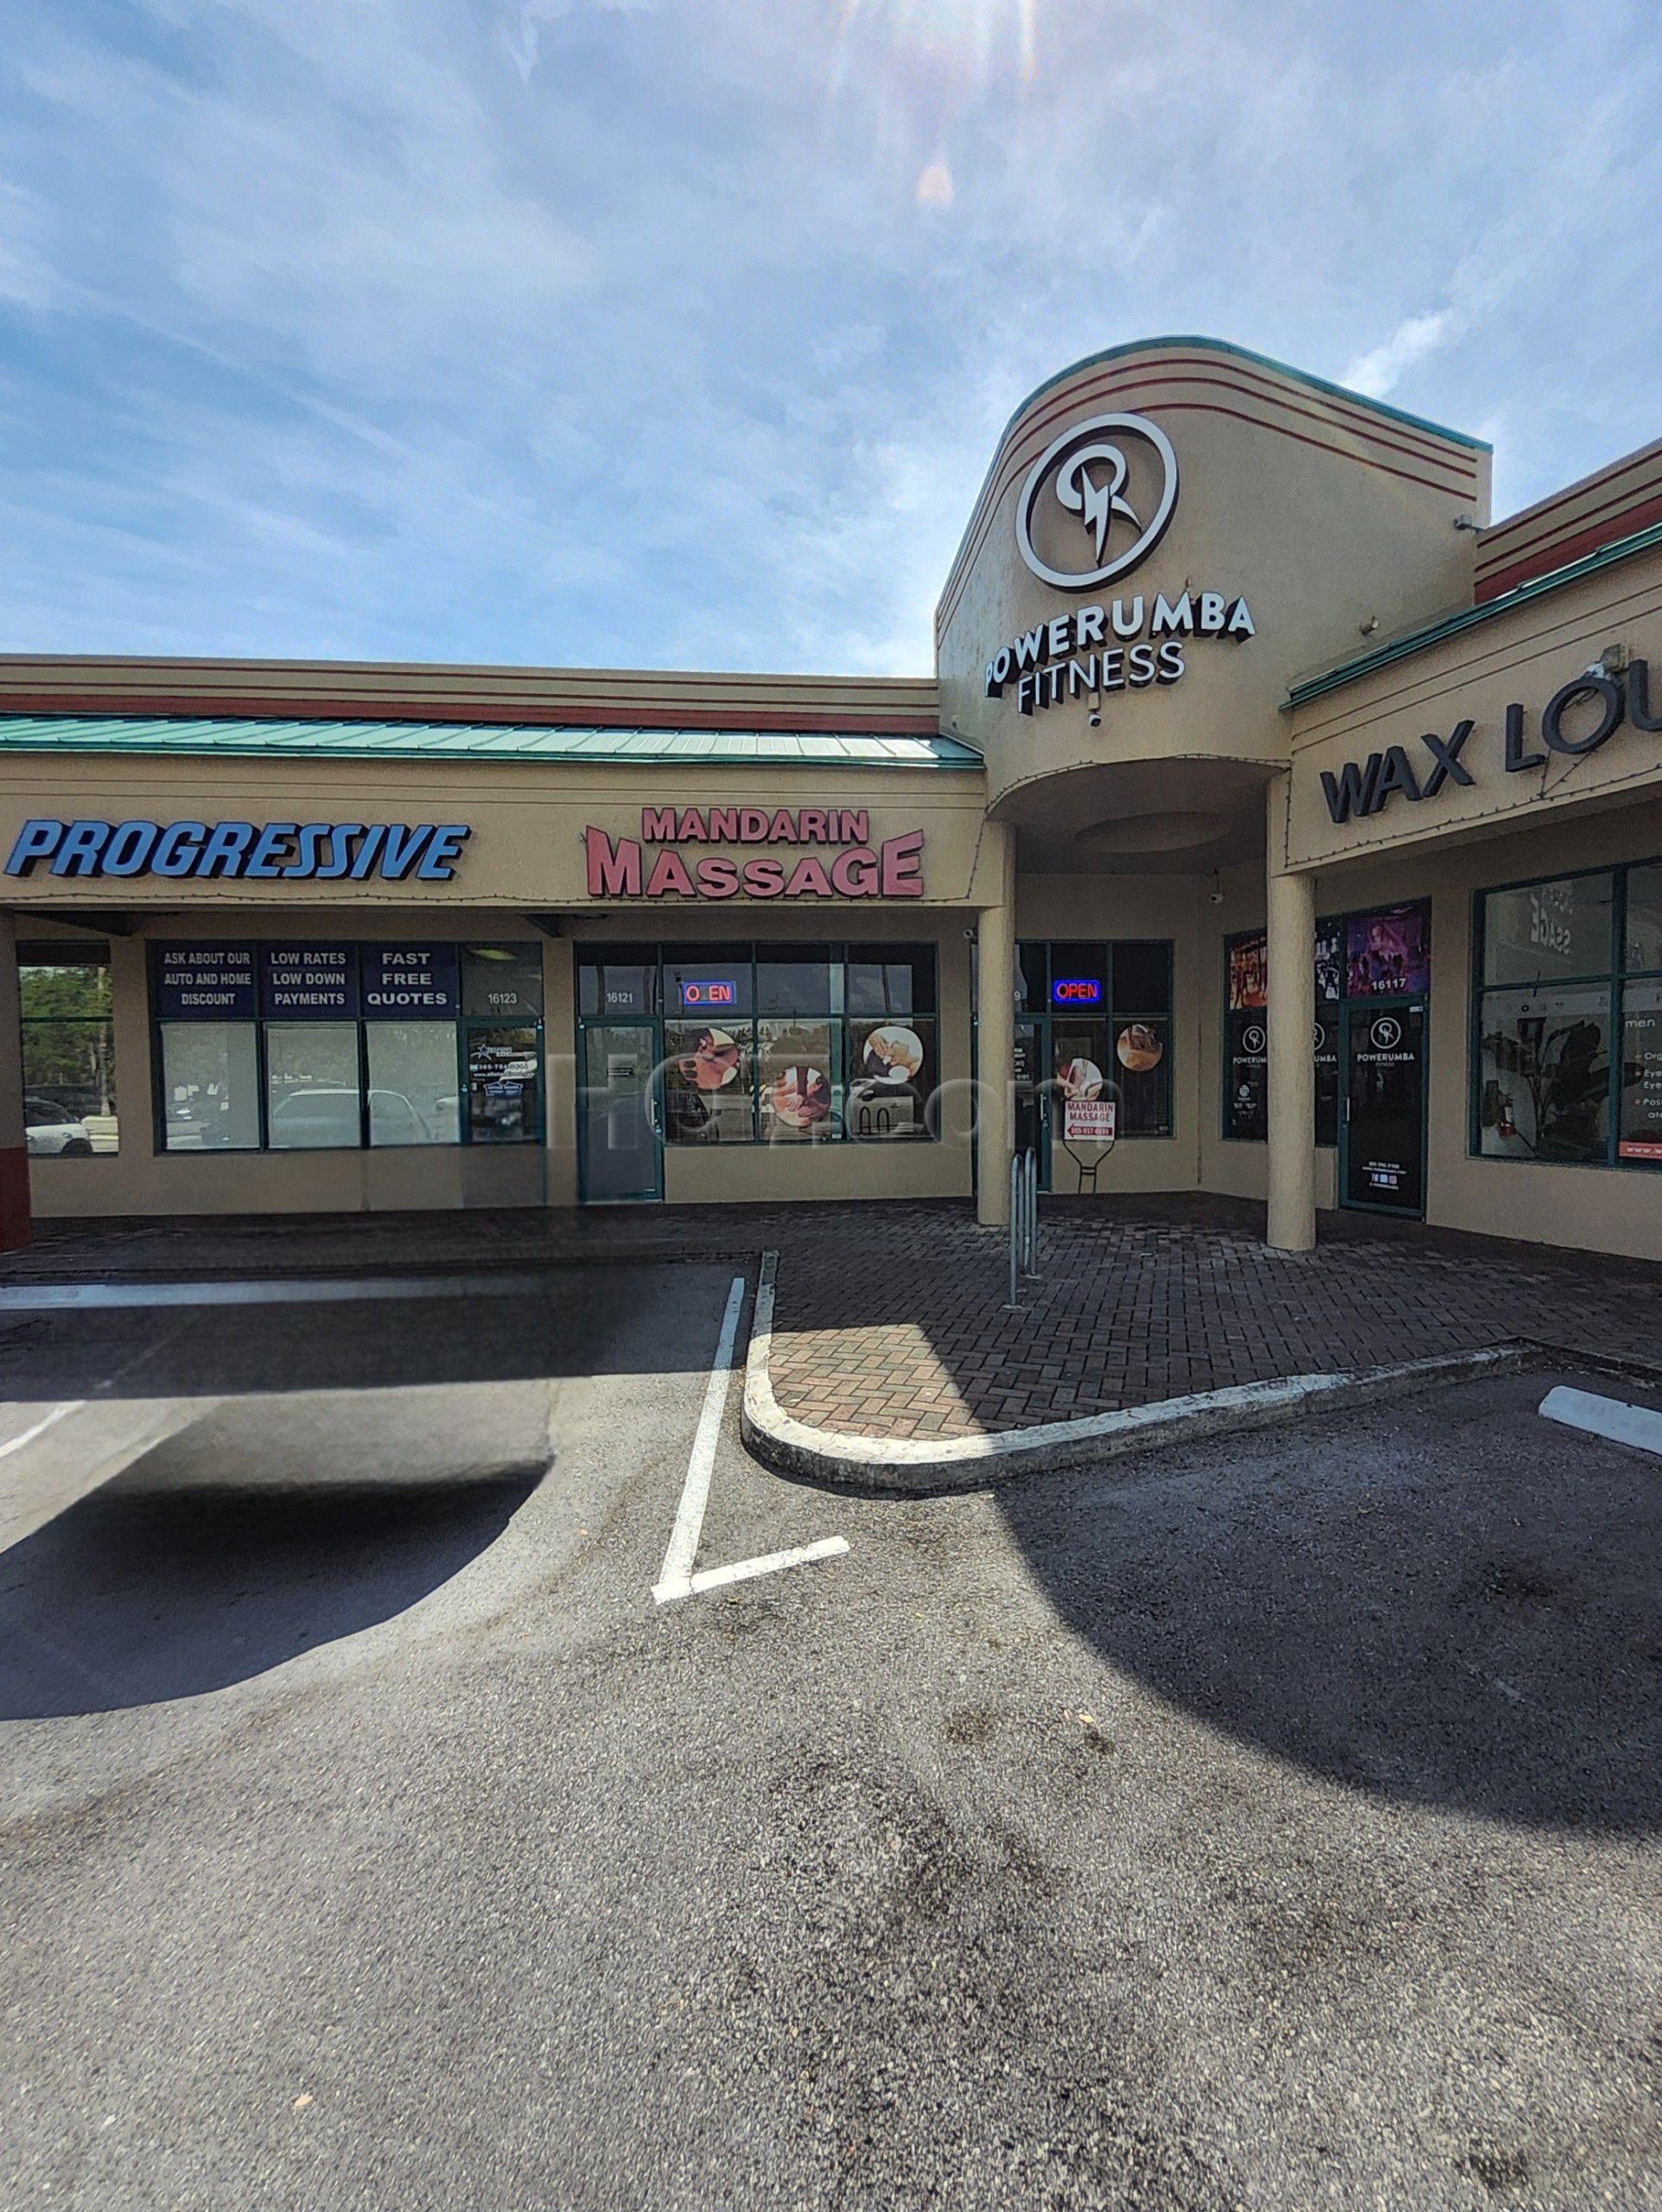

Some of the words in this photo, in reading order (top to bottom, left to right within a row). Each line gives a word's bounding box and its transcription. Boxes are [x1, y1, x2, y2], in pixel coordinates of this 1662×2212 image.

[984, 591, 1256, 697] POWERUMBA
[1017, 641, 1186, 715] FITNESS
[1319, 719, 1477, 823] WAX
[641, 807, 869, 843] MANDARIN
[3, 818, 471, 881] PROGRESSIVE
[585, 824, 924, 898] MASSAGE
[164, 952, 186, 964] ASK
[188, 952, 225, 964] ABOUT
[227, 952, 251, 964] OUR
[271, 952, 300, 964] LOW
[303, 952, 346, 964] RATES
[382, 953, 430, 965] FAST
[164, 973, 194, 985] AUTO
[195, 973, 218, 985] AND
[220, 973, 252, 985] HOME
[272, 973, 302, 985] LOW
[305, 973, 346, 985] DOWN
[382, 973, 432, 985] FREE
[1371, 977, 1407, 991] 16117
[685, 984, 730, 1002] OEN
[1056, 982, 1098, 1000] OPEN
[181, 993, 236, 1005] DISCOUNT
[274, 993, 346, 1005] PAYMENTS
[367, 993, 448, 1006] QUOTES
[487, 993, 518, 1005] 16123
[606, 991, 634, 1004] 16121
[1357, 1052, 1415, 1062] POWERUMBA
[1067, 1103, 1114, 1113] MANDARIN
[1069, 1112, 1111, 1122] MASSAGE
